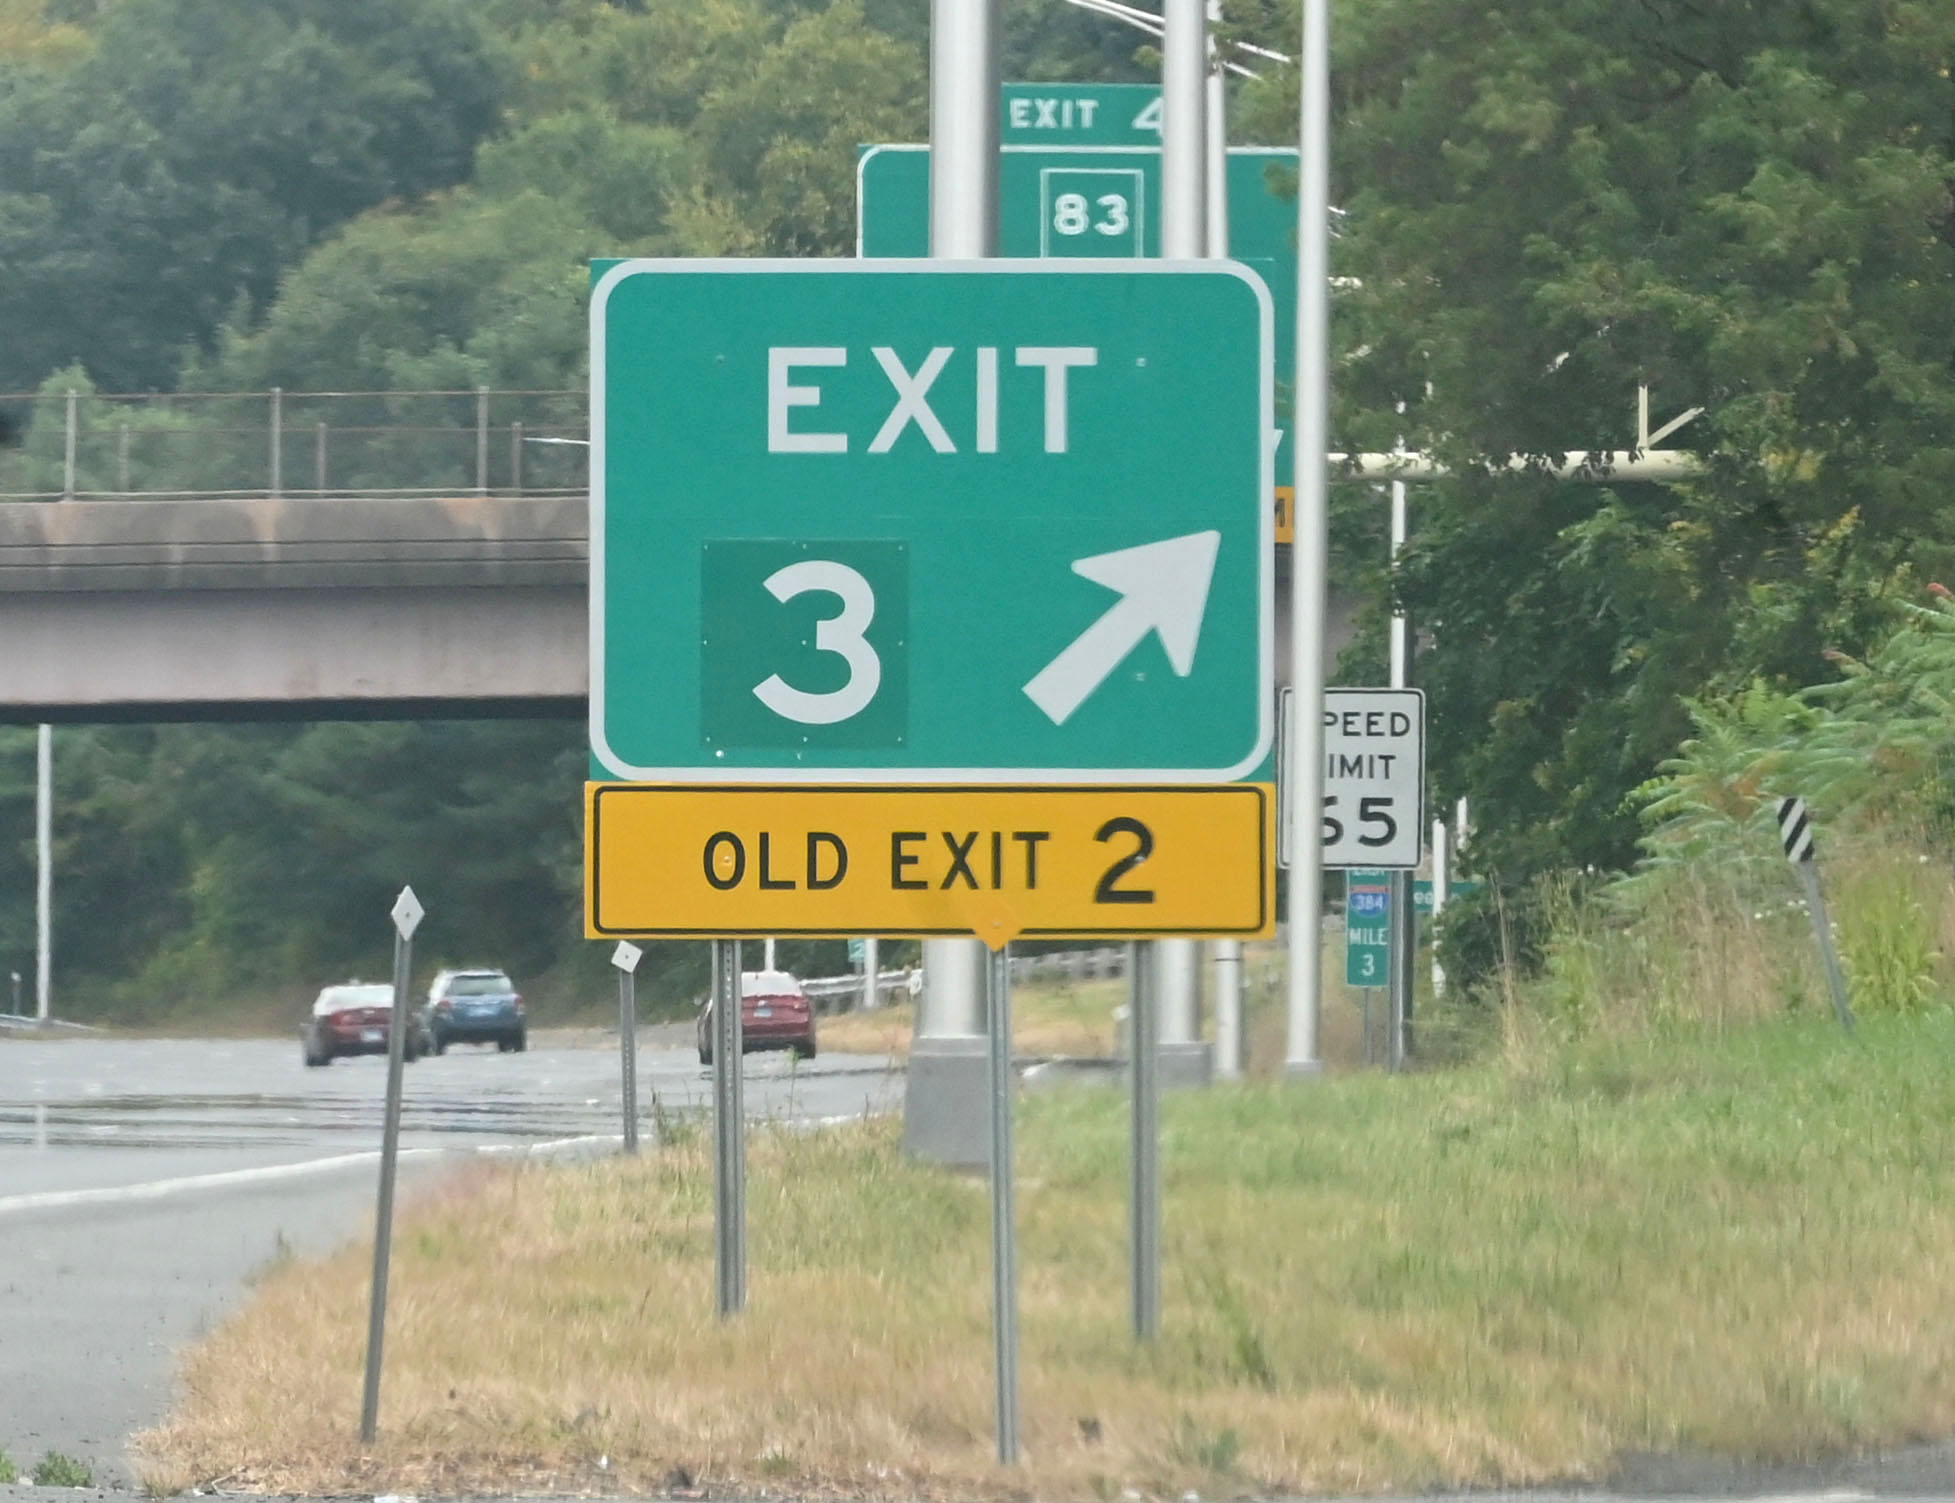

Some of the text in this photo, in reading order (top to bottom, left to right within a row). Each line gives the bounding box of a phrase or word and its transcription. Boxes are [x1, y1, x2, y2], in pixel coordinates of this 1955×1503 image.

[1009, 96, 1166, 136] EXIT 4
[1053, 192, 1130, 236] 83
[767, 346, 1098, 454] EXIT
[752, 560, 881, 725] 3
[1322, 711, 1410, 737] PEED
[1328, 754, 1397, 780] IMIT
[703, 816, 1156, 904] OLD EXIT 2
[1350, 928, 1388, 946] MILE
[1362, 954, 1375, 976] 3
